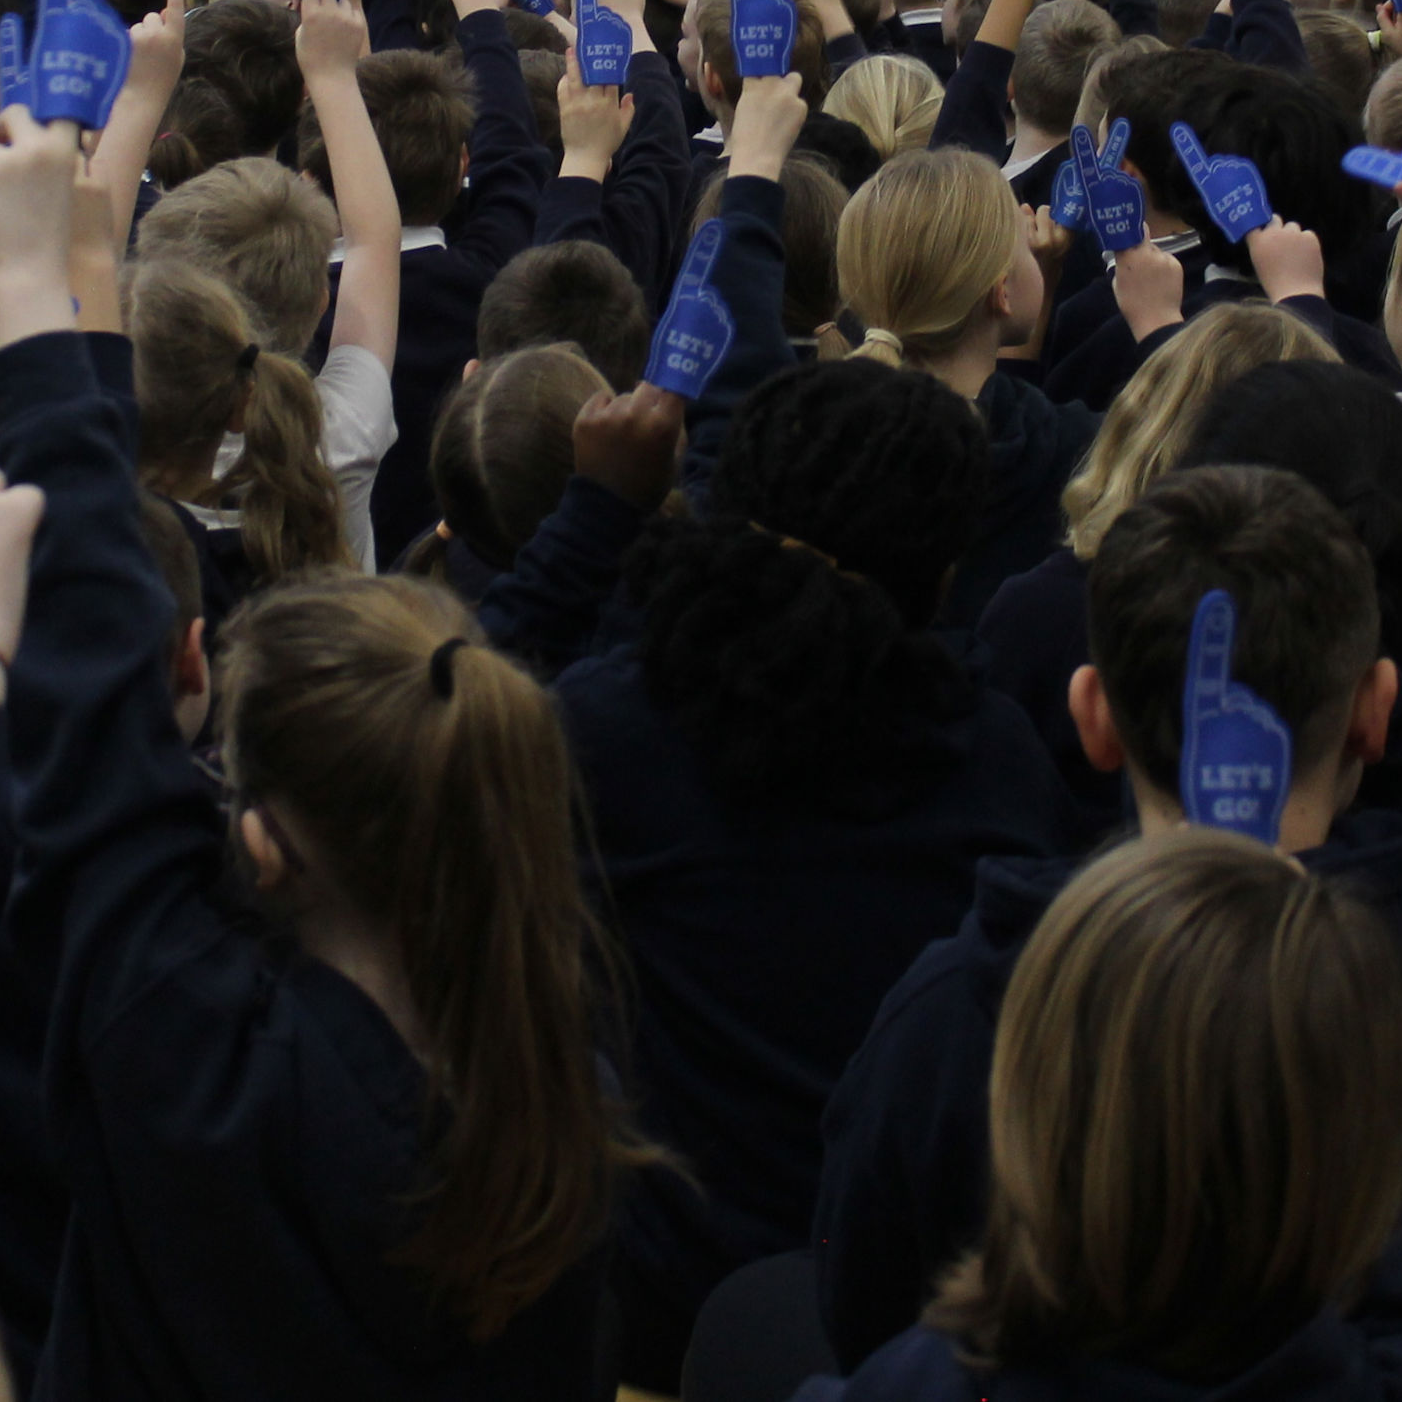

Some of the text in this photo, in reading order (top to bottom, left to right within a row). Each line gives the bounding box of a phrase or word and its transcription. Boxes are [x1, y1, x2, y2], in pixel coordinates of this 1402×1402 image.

[740, 26, 782, 40] LET'S
[587, 44, 623, 56] LET'S
[745, 42, 774, 57] GO!
[42, 51, 107, 79] LET'S
[593, 58, 616, 70] GO!
[1215, 183, 1254, 212] LET'S
[1062, 200, 1084, 221] #1
[1097, 204, 1134, 222] LET'S
[1228, 201, 1254, 222] GO!
[1105, 220, 1130, 235] GO!
[667, 329, 714, 359] LET'S
[667, 354, 700, 376] GO!
[1202, 764, 1273, 789] LET'S
